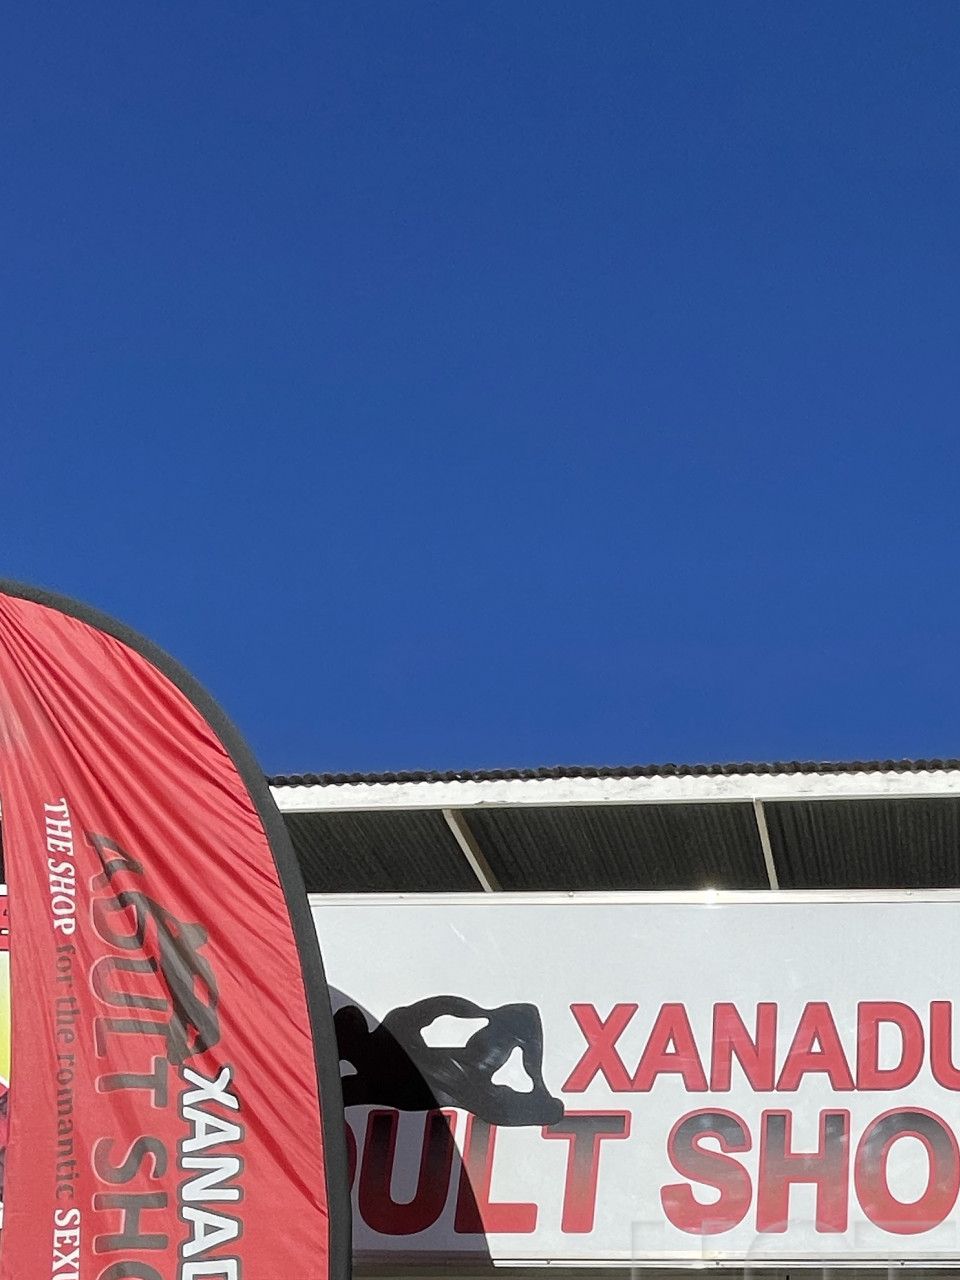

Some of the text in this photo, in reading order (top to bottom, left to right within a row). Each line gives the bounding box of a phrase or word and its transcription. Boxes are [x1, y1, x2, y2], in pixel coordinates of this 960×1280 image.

[44, 797, 74, 856] THE
[49, 857, 77, 936] SHOP
[55, 943, 77, 987] for
[86, 831, 170, 1109] ADULT
[55, 995, 82, 1045] the
[55, 1053, 79, 1201] romantic
